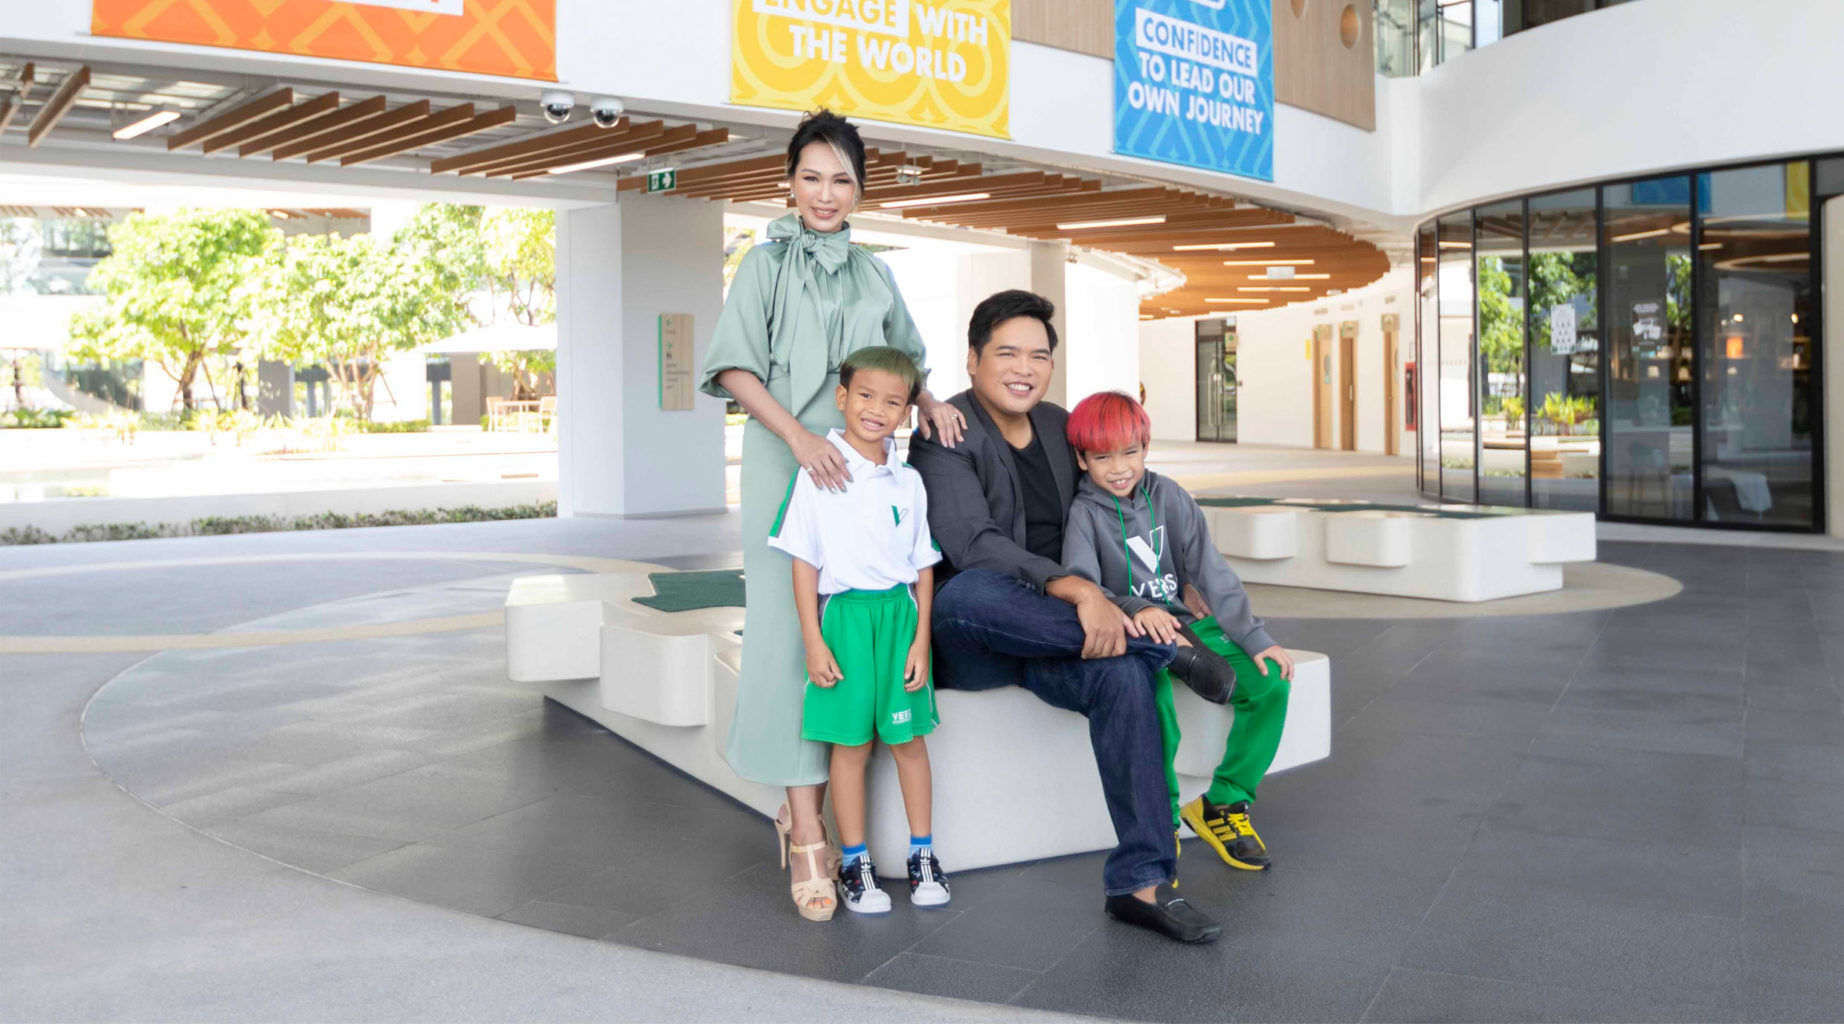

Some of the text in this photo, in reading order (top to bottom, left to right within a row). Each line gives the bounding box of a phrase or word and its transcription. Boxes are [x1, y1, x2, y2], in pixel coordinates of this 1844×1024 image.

[914, 3, 988, 47] WITH
[1142, 17, 1252, 70] CONFIDENCE
[788, 24, 968, 84] THE WORLD
[1138, 51, 1256, 105] TO LEAD OUR
[1127, 81, 1265, 136] OWN JOURNEY
[1130, 573, 1178, 598] VERS
